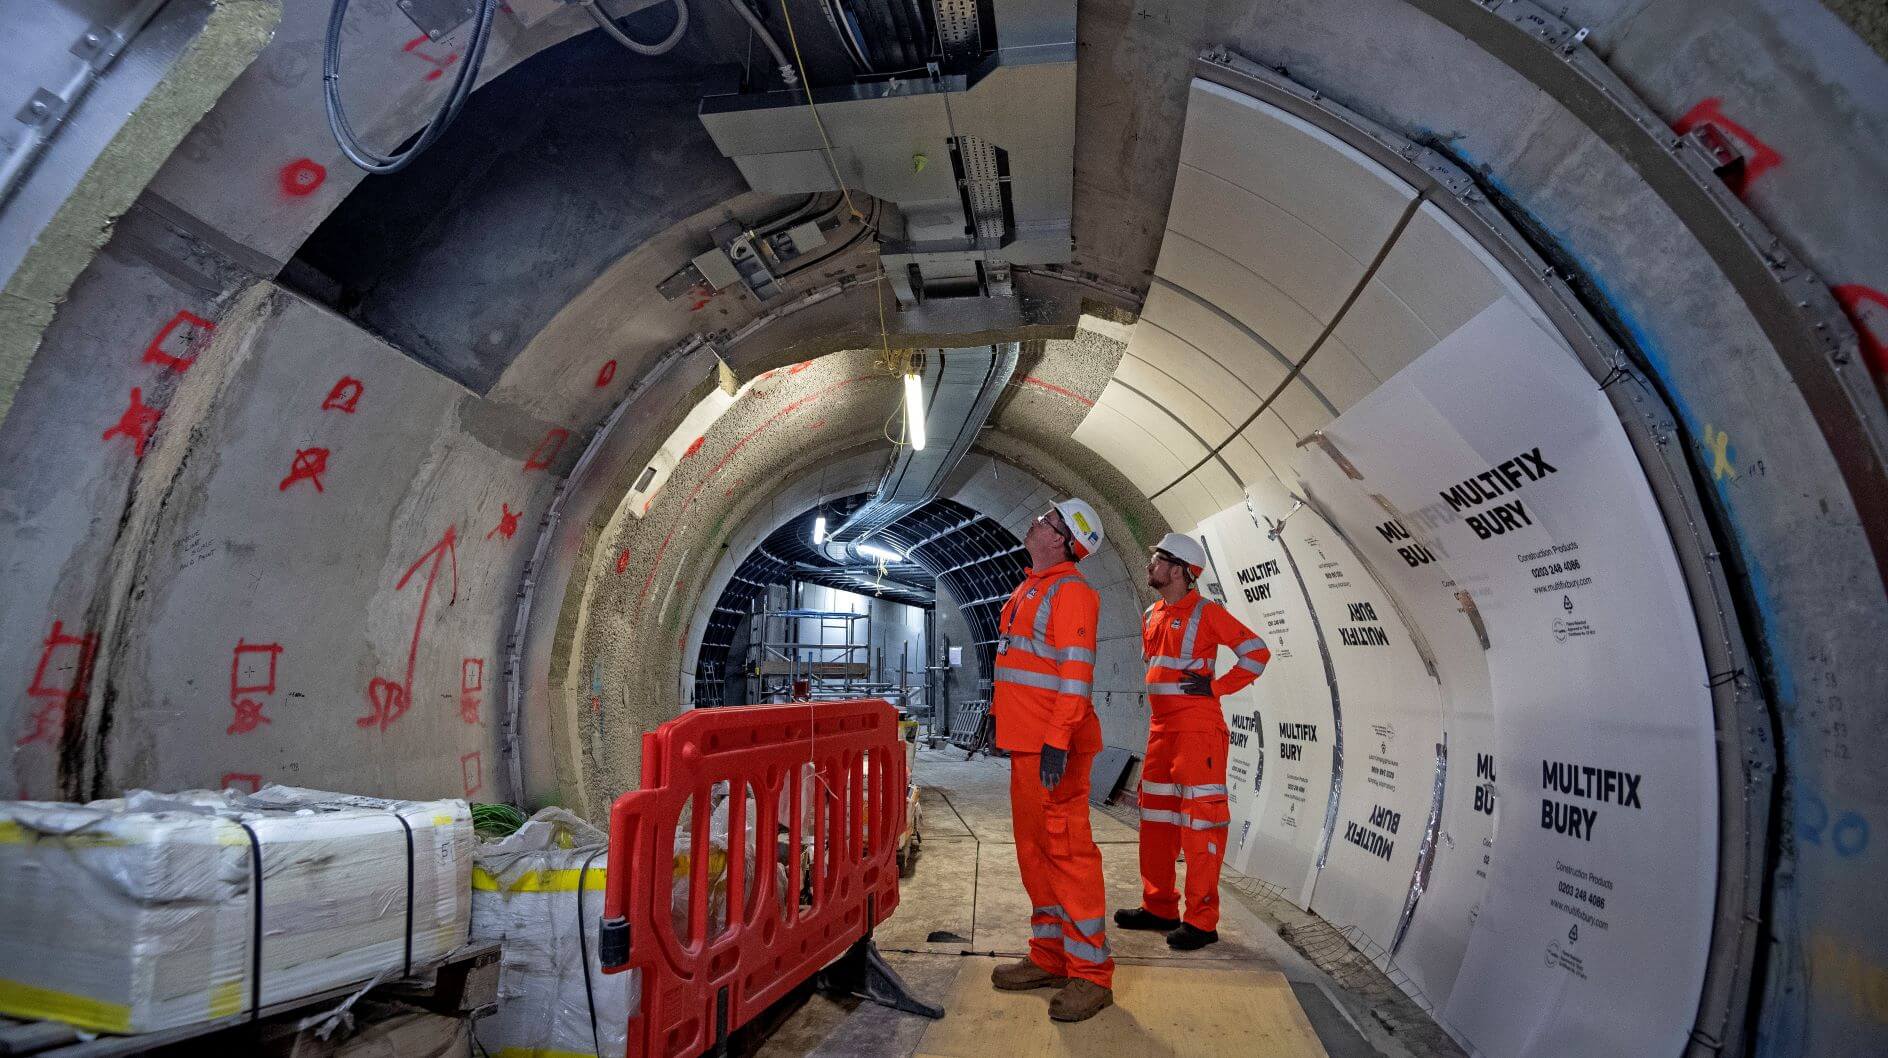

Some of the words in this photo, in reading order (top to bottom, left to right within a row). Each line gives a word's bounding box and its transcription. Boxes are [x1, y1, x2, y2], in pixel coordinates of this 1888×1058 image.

[1439, 447, 1558, 512] MULTIFIX
[1465, 500, 1533, 540] BURY
[1517, 548, 1553, 563] Construction
[1552, 541, 1579, 554] Products
[1236, 559, 1281, 585] MULTIFIX
[1531, 566, 1549, 578] 0203
[1549, 563, 1563, 575] 248
[1243, 582, 1272, 603] BURY
[1347, 602, 1378, 621] BURY
[1338, 626, 1390, 646] MULTIFIX
[1230, 732, 1249, 749] BURY
[1279, 722, 1318, 743] MULTIFIX
[1280, 742, 1303, 762] BURY
[1542, 759, 1641, 809] MULTIFIX
[1368, 804, 1401, 835] BURY
[1541, 799, 1598, 841] BURY
[1344, 820, 1395, 862] MULTIFIX
[1555, 860, 1588, 880] Construction
[1588, 872, 1613, 890] Products
[1558, 881, 1574, 896] 0203
[1574, 888, 1587, 902] 248
